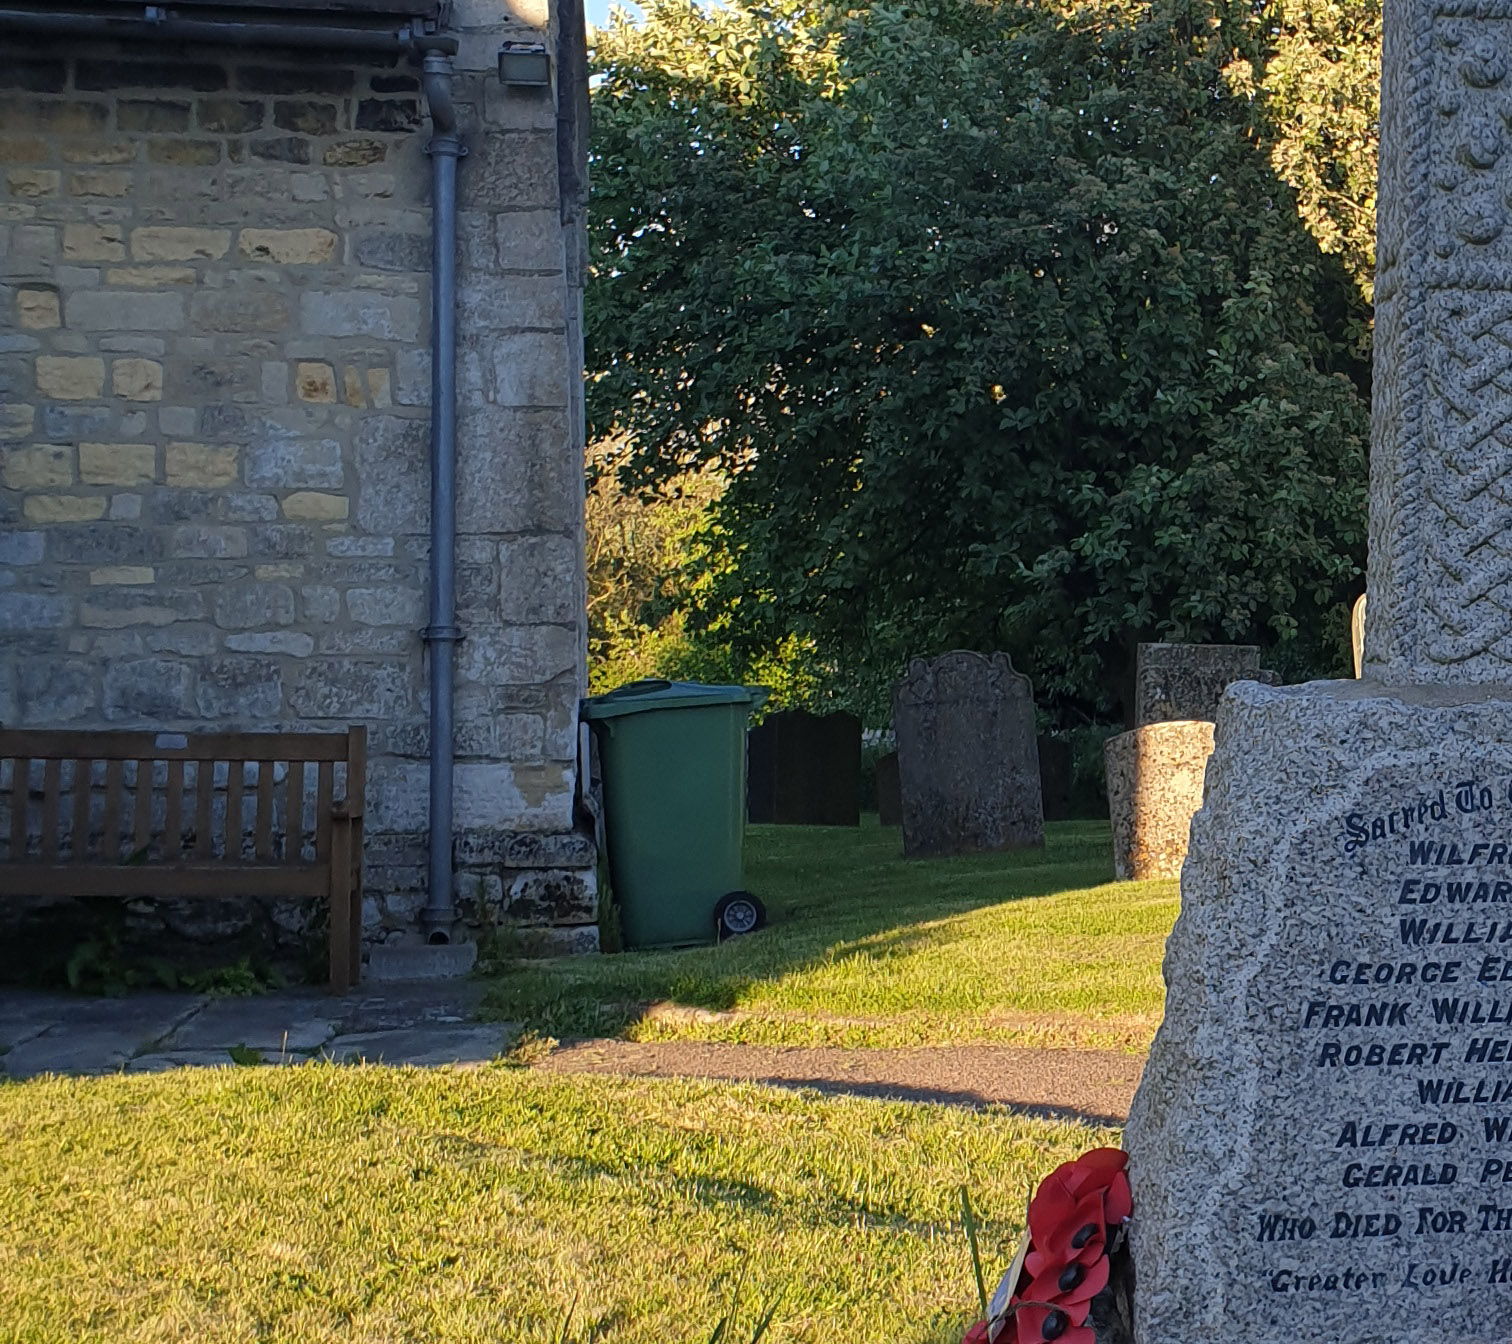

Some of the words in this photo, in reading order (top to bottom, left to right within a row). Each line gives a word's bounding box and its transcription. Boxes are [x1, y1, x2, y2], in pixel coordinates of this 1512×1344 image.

[1344, 789, 1449, 853] Sacred
[1455, 780, 1493, 813] To
[1329, 960, 1462, 985] GEORGE
[1302, 1001, 1412, 1029] FRANK
[1317, 1041, 1451, 1068] ROBERT
[1335, 1121, 1458, 1148] ALFRED
[1342, 1163, 1458, 1188] GERALD
[1256, 1213, 1317, 1243] WHO
[1330, 1211, 1403, 1239] DIED
[1415, 1207, 1468, 1235] FOR
[1401, 1261, 1472, 1288] Love
